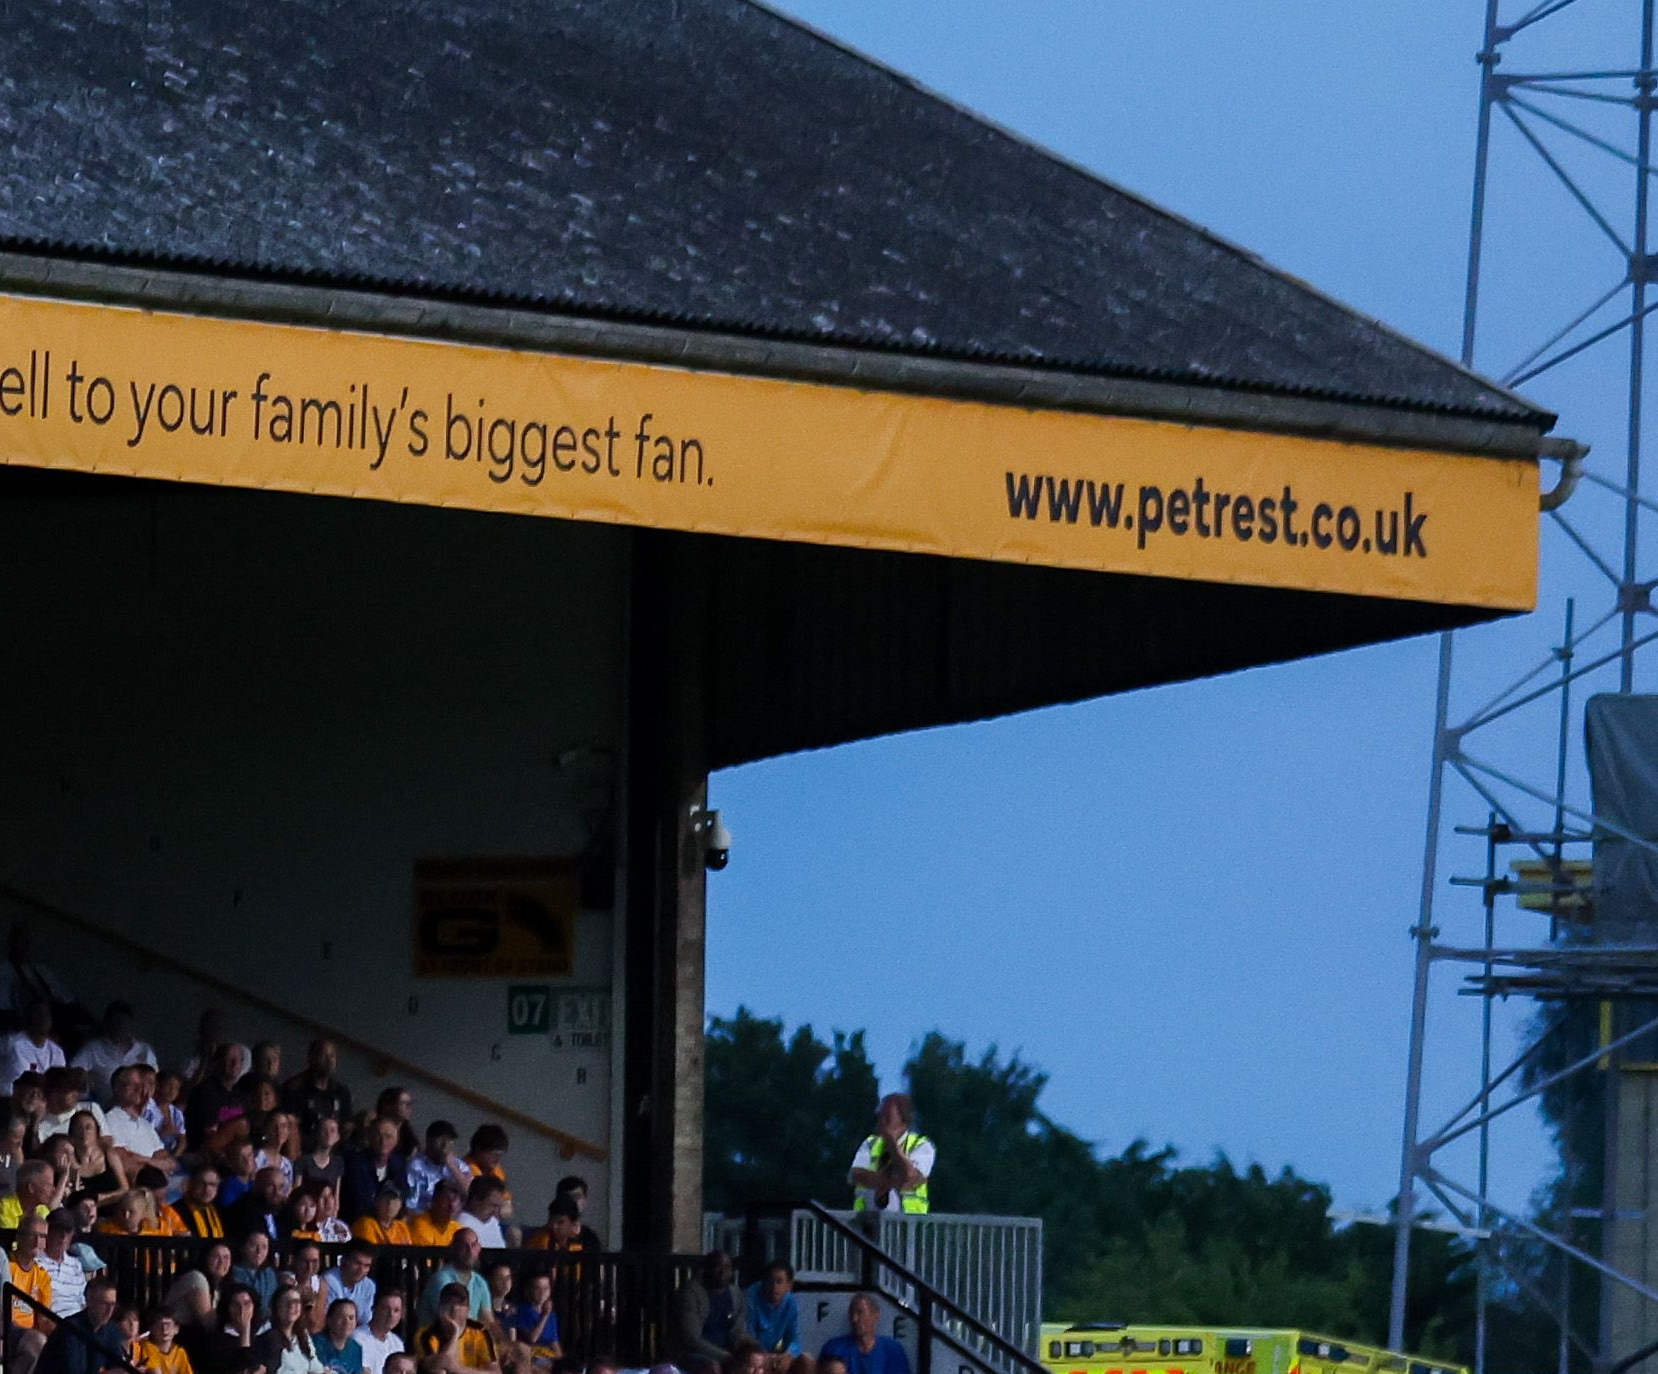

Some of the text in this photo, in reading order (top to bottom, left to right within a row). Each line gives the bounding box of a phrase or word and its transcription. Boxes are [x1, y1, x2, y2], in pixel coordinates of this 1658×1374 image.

[65, 360, 115, 426] to
[126, 381, 238, 448] your
[251, 372, 429, 471] family's
[445, 393, 621, 487] biggest
[634, 413, 715, 487] fan.
[1005, 471, 1428, 559] www.petrest.co.uk
[511, 993, 546, 1026] 07
